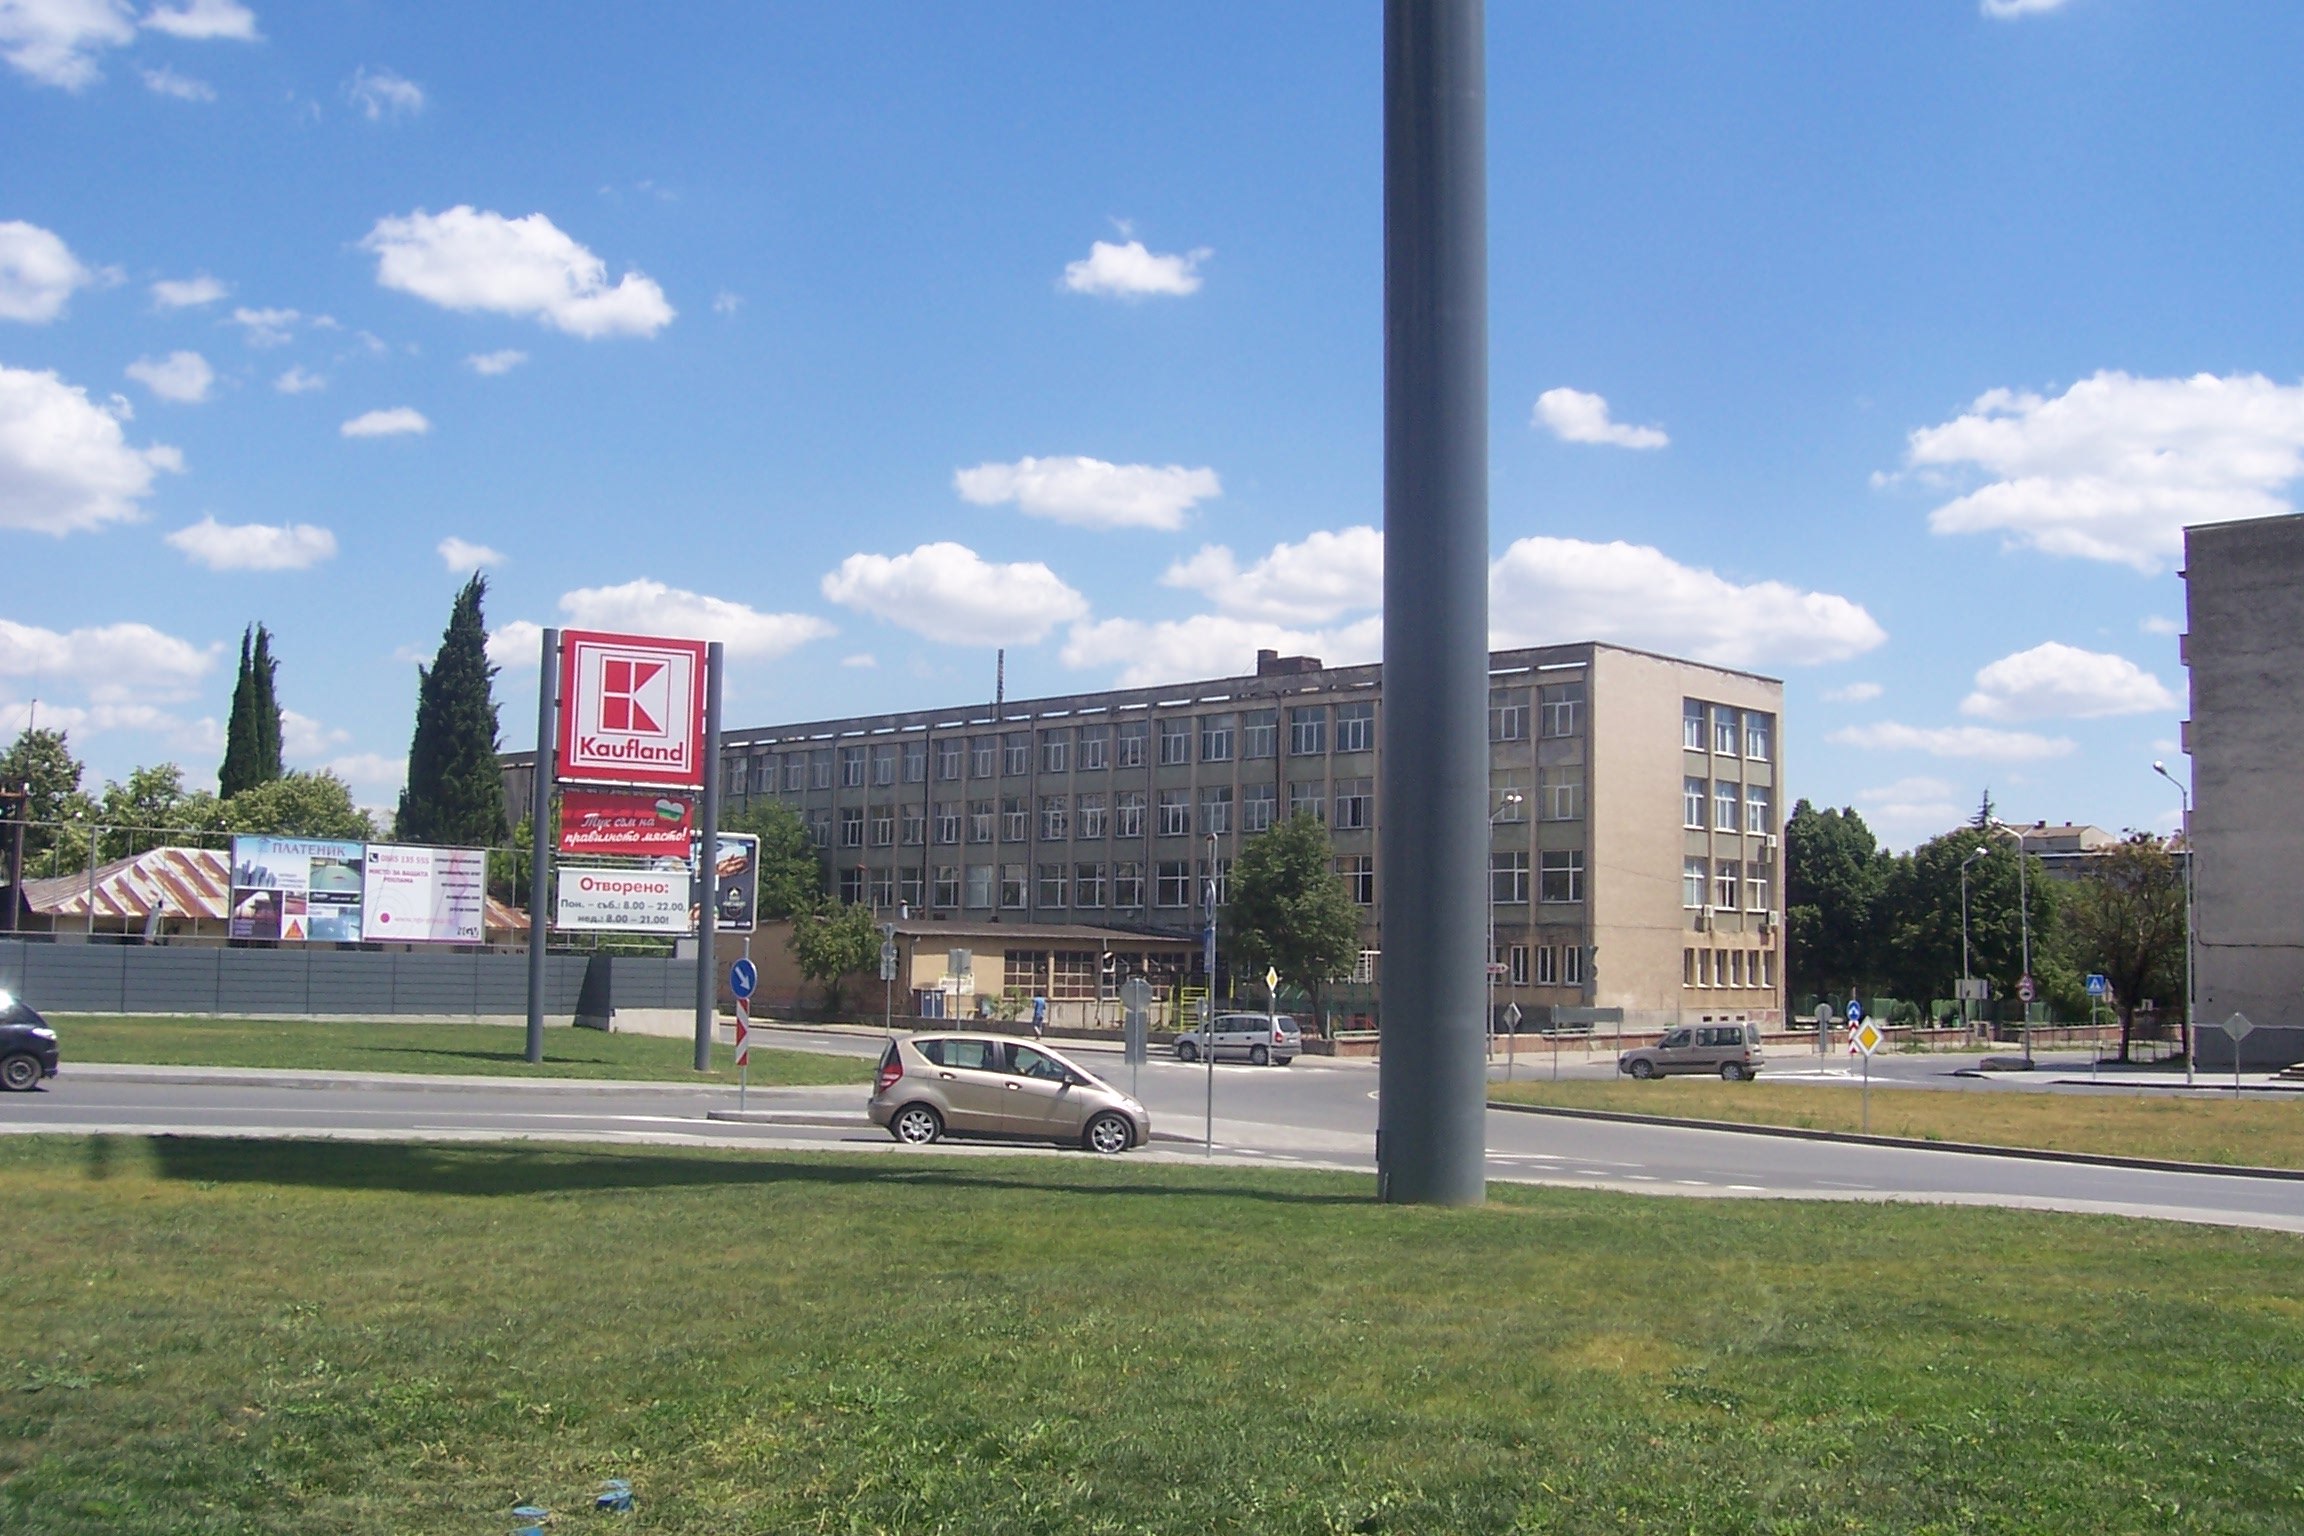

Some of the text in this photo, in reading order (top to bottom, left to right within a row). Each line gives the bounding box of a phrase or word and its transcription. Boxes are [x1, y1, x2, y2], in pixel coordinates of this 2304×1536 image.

[579, 736, 684, 762] Kaufland
[581, 813, 612, 831] Тук
[639, 818, 655, 827] на
[565, 827, 687, 847] правилното място!
[272, 842, 346, 857] ПЛАТЕНИК
[580, 877, 669, 896] Отворено:
[560, 898, 585, 908] Пон.
[623, 901, 645, 910] 8.00
[606, 914, 628, 923] 8.00
